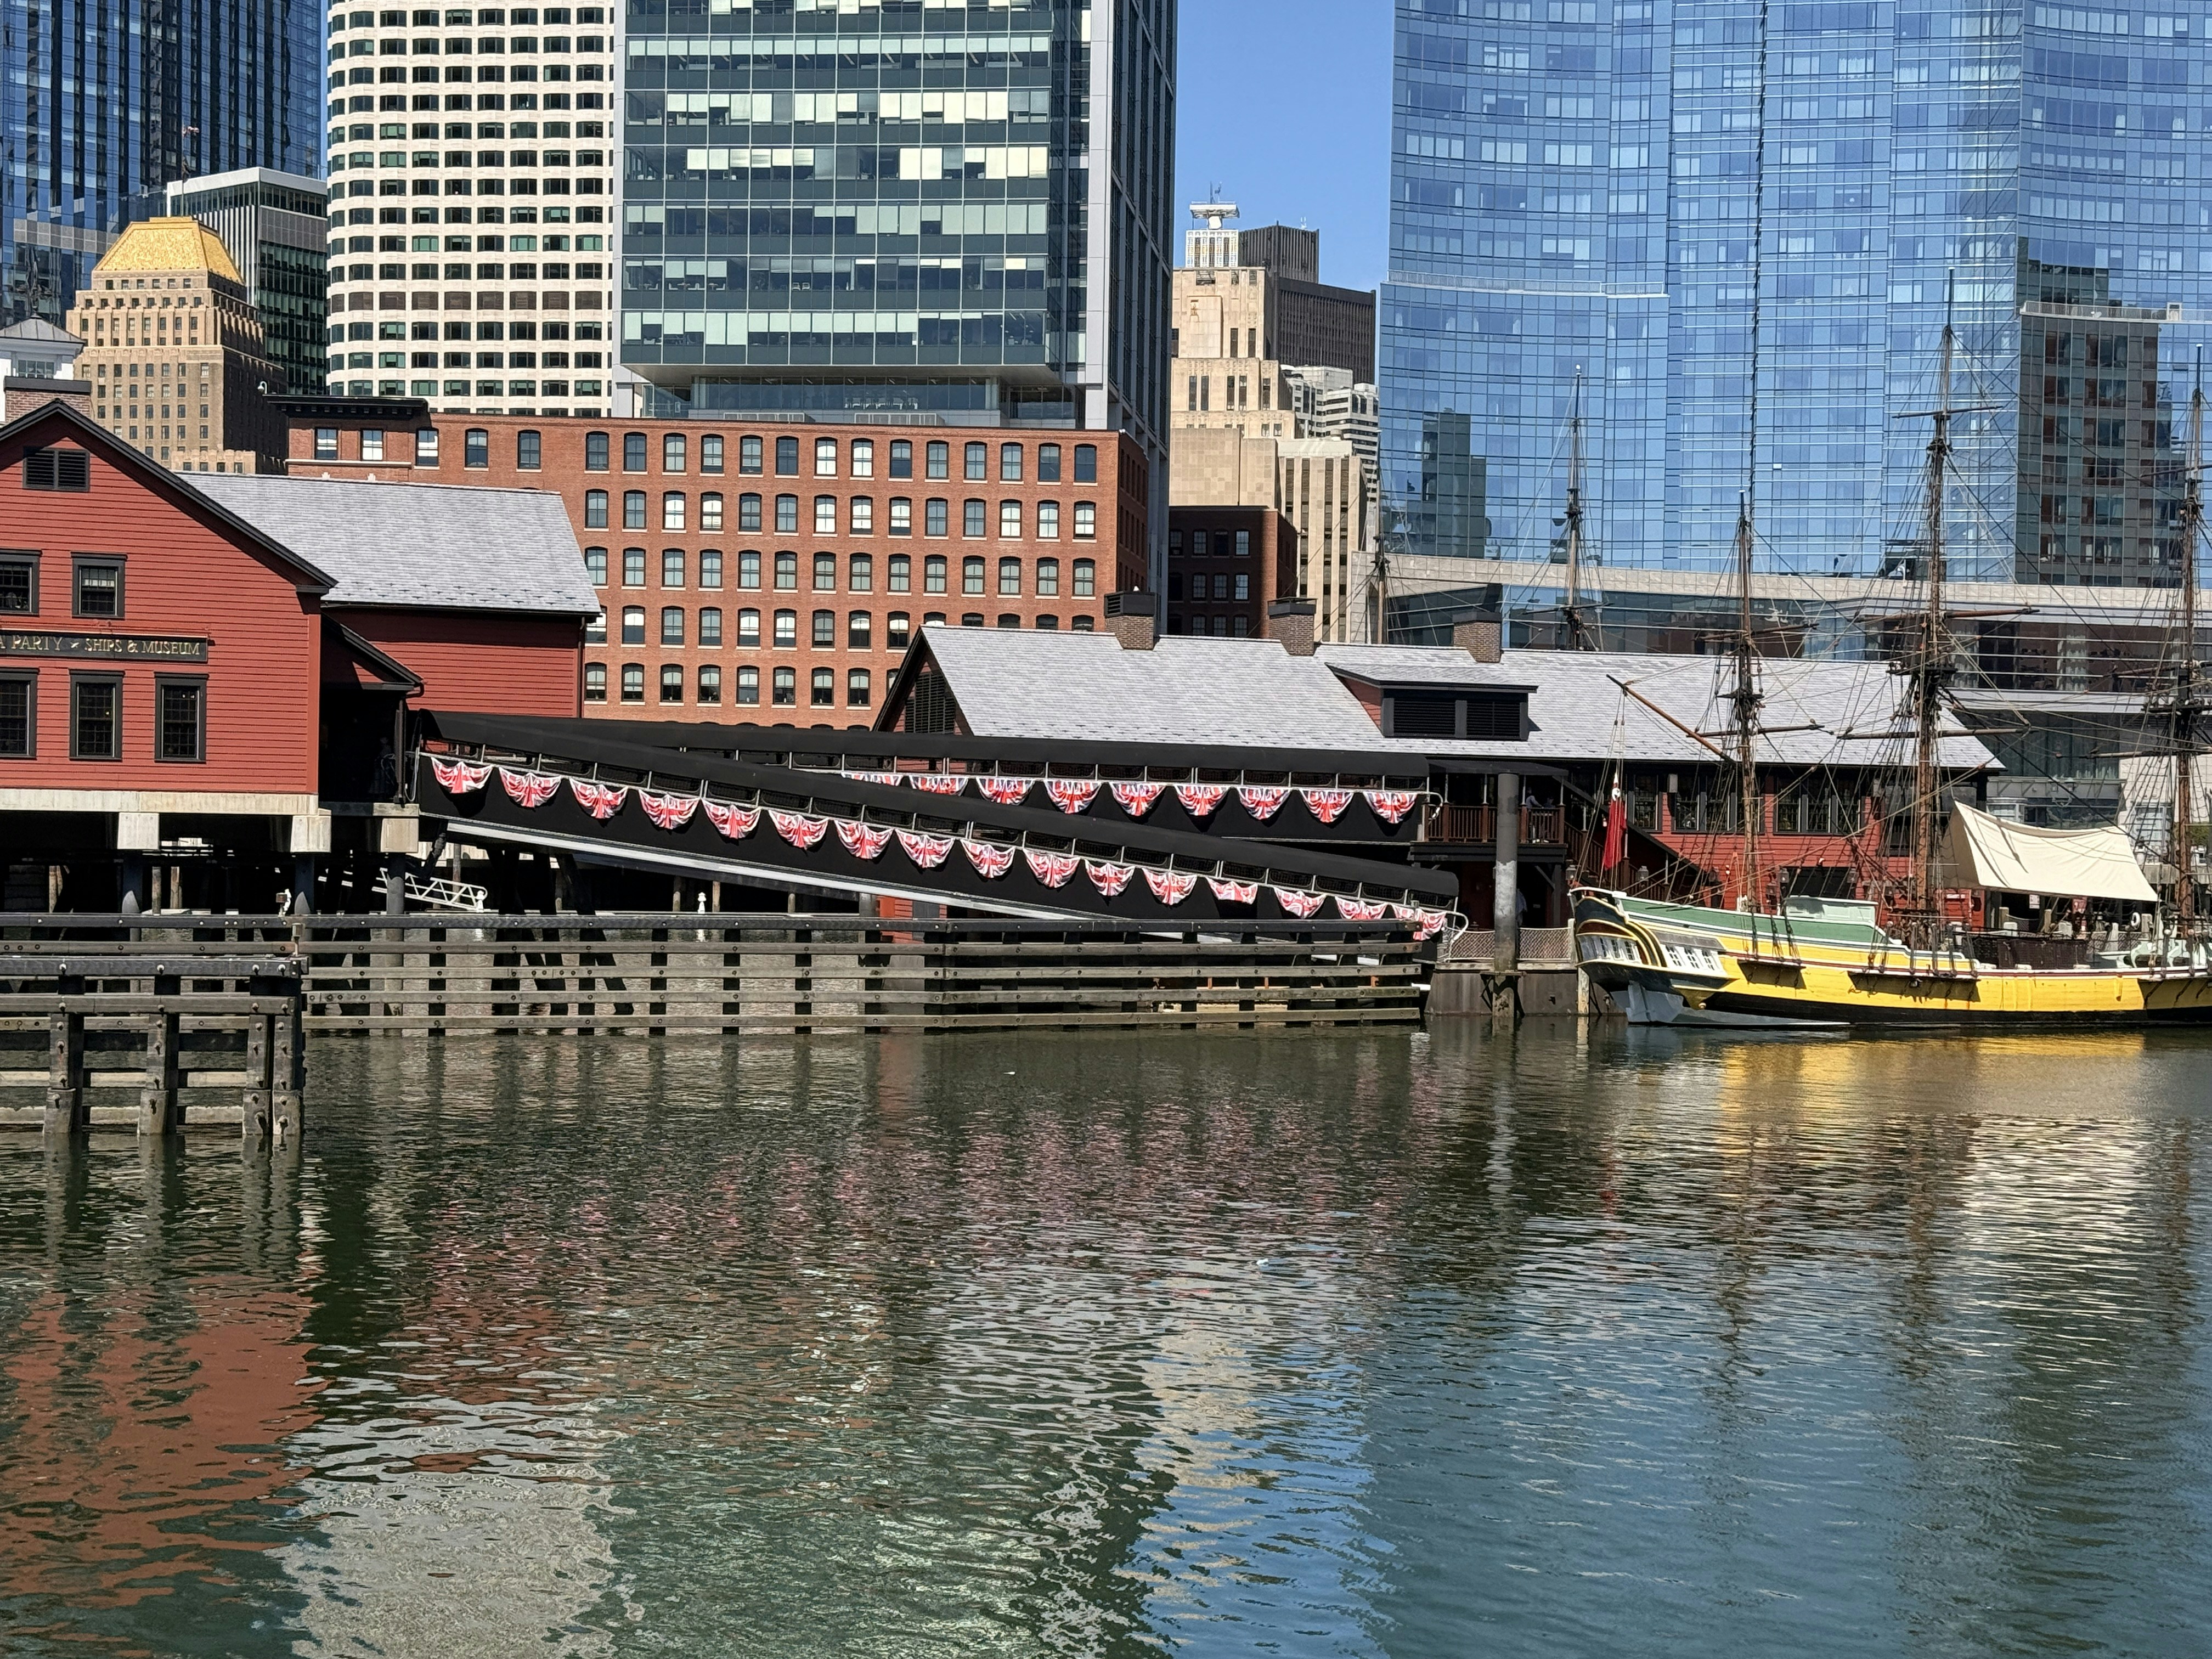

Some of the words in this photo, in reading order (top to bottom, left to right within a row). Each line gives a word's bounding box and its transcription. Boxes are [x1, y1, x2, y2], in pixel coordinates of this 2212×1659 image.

[11, 635, 63, 651] PARTY
[84, 638, 122, 652] SHIPS
[127, 640, 138, 653] &
[142, 640, 200, 655] MUSEUM
